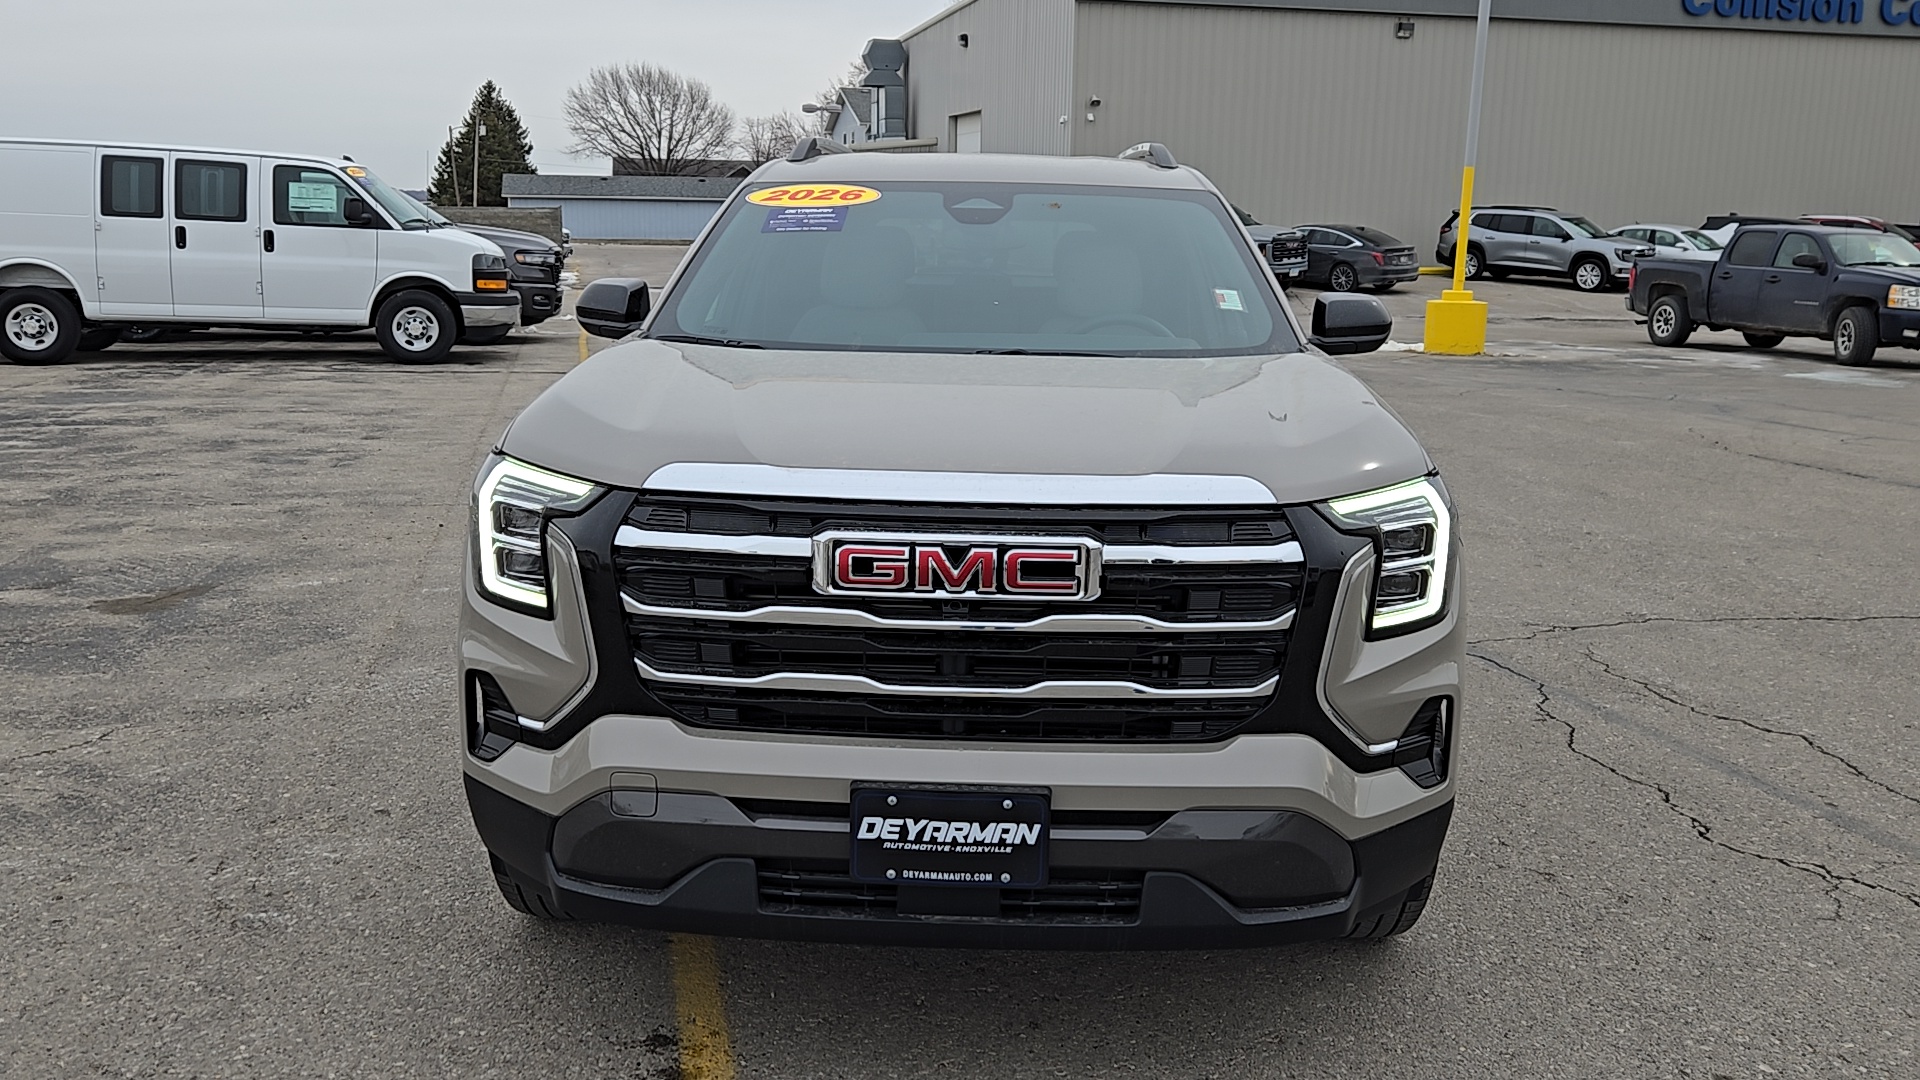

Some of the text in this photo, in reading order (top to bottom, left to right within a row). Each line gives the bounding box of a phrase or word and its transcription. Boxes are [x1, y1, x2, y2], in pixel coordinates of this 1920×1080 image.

[760, 189, 866, 202] 2026
[835, 544, 1079, 593] GMC
[857, 816, 1041, 845] DEYARMAN
[903, 869, 993, 882] DEYARMANAUTO.COM
